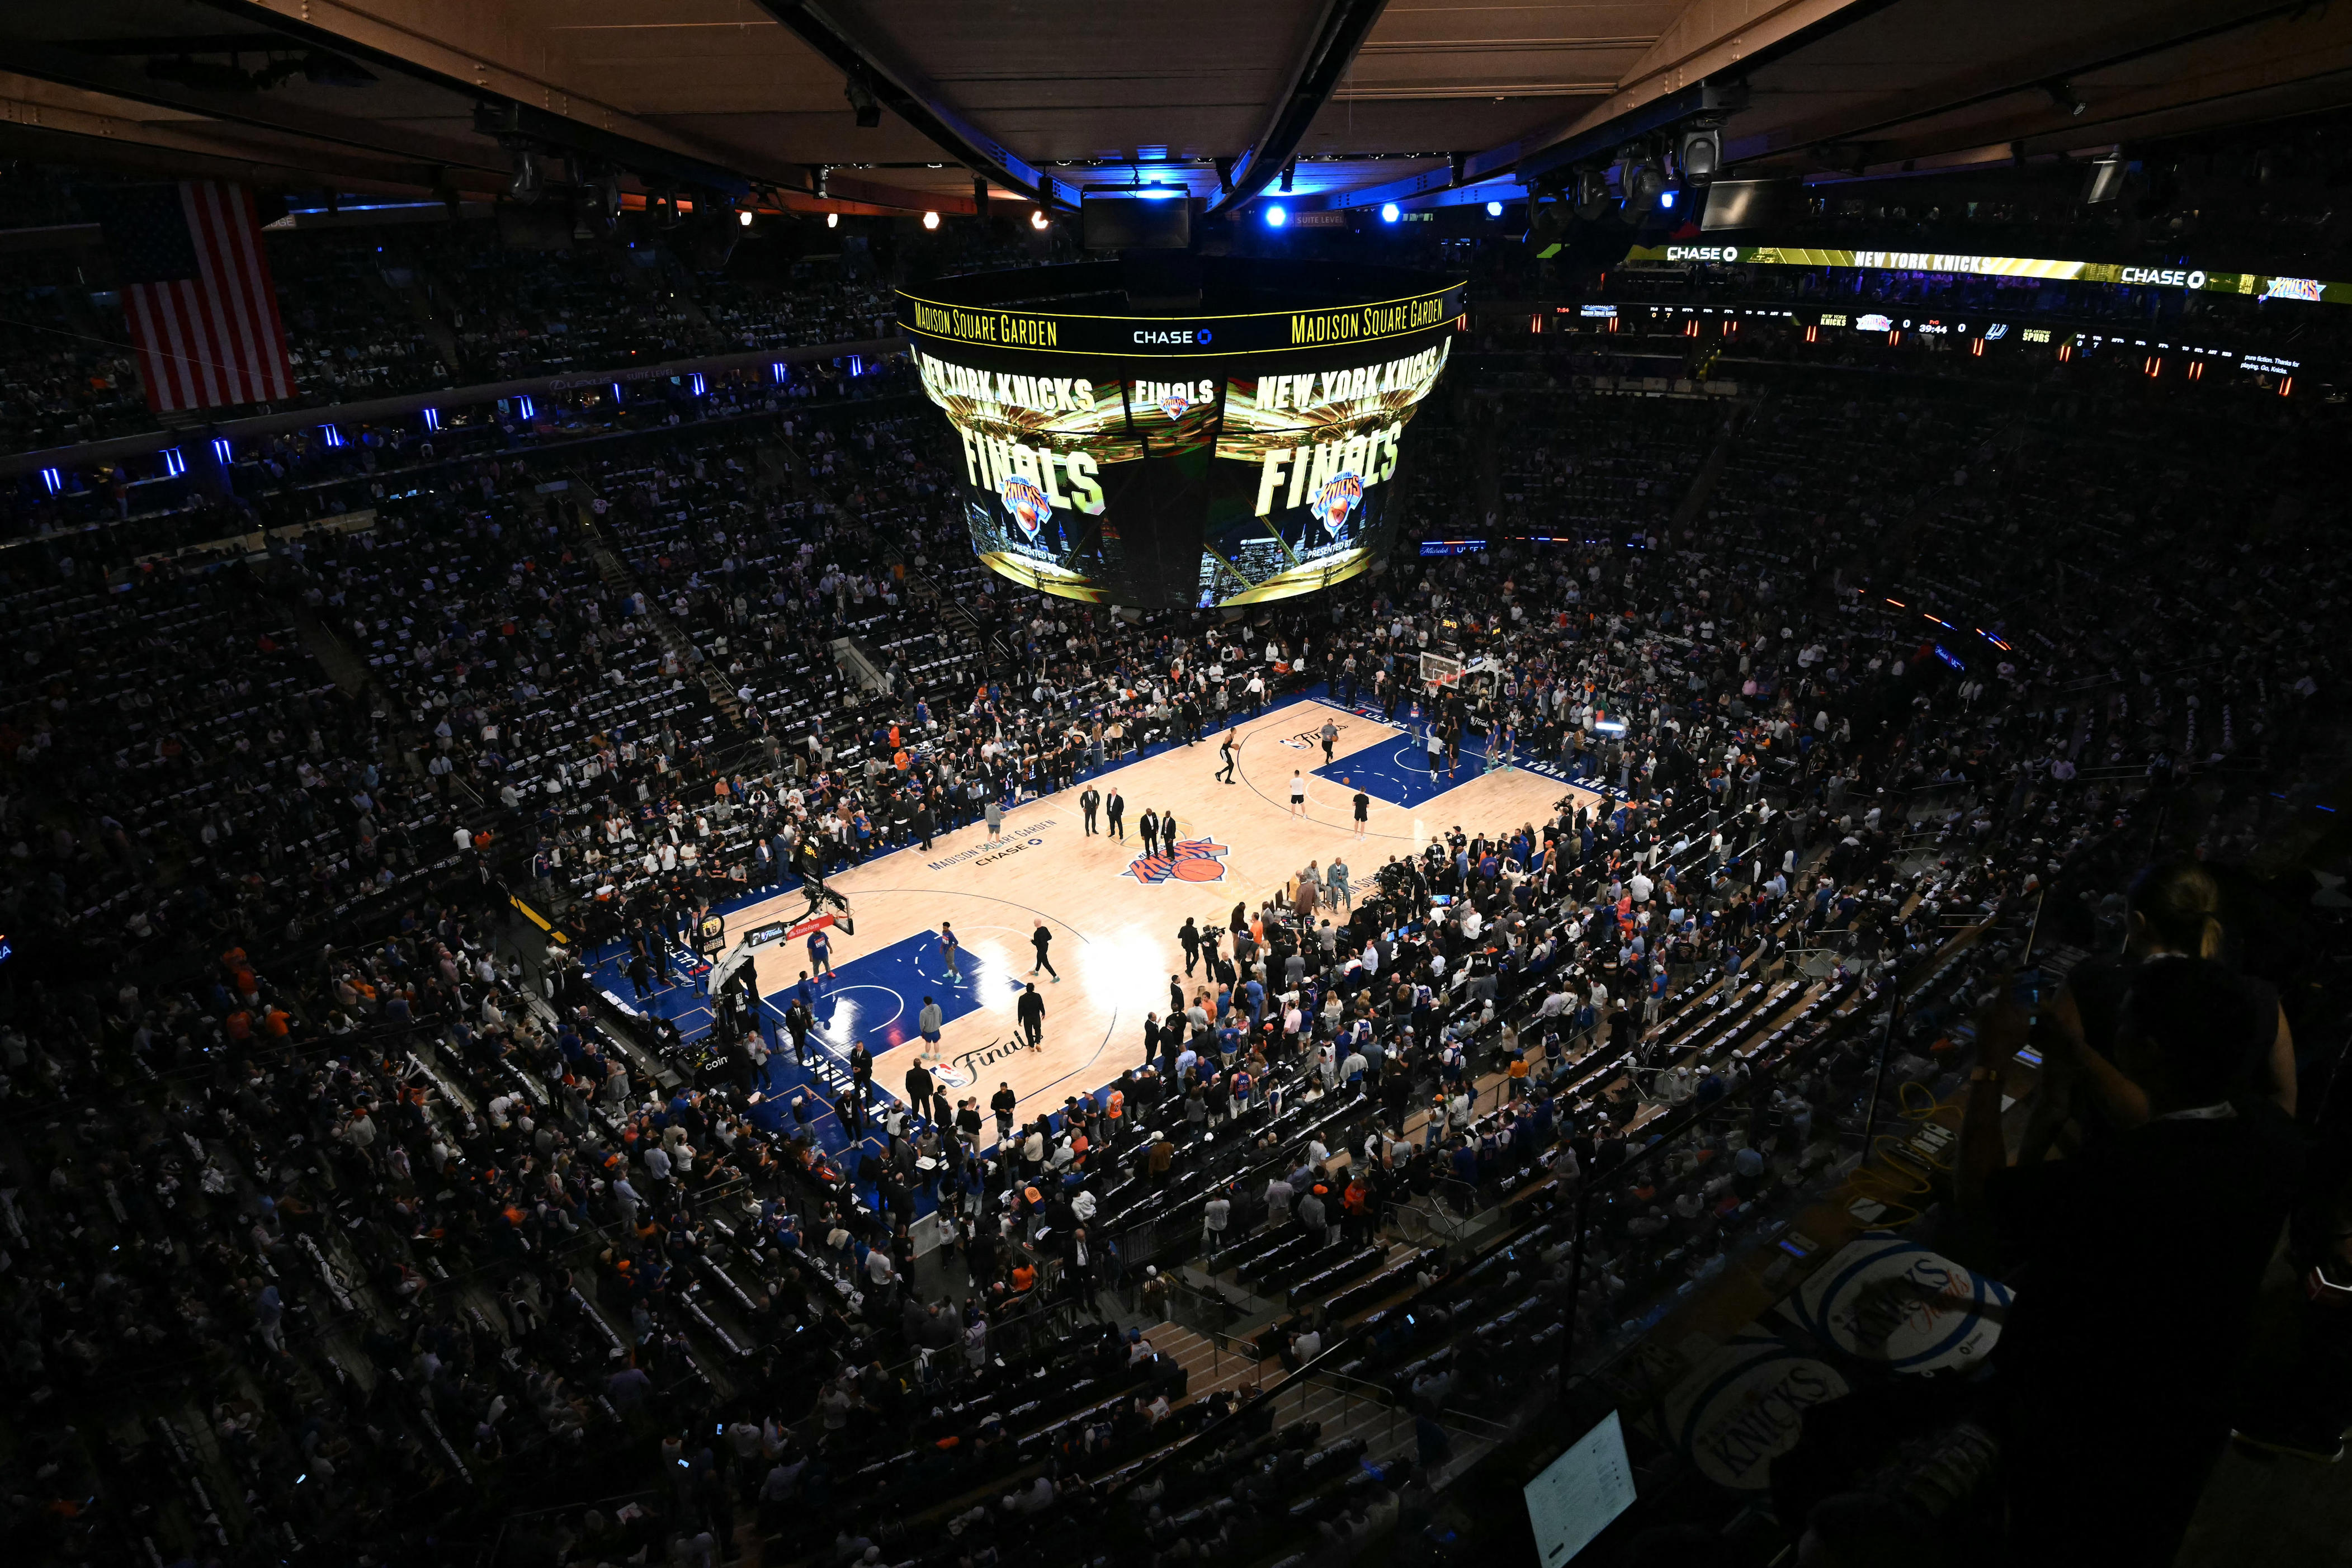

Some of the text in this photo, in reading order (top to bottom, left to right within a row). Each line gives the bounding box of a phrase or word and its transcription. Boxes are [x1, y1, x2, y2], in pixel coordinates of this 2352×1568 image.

[1666, 247, 1720, 261] CHASE
[1854, 251, 1991, 272] NEW YORK KNICKS
[2121, 267, 2186, 286] CHASE
[2269, 277, 2318, 299] KNICKS
[1820, 318, 1846, 327] KNICKS
[1902, 319, 1910, 328] 0
[1919, 324, 1947, 334] 39:44
[1958, 323, 1966, 333] 0
[1134, 331, 1193, 344] CHASE
[2022, 332, 2050, 343] SPURS
[2240, 362, 2259, 371] playing.
[2274, 358, 2292, 366] Thanks
[945, 361, 996, 404] YORK
[996, 372, 1097, 412] KNICKS
[1255, 372, 1316, 410] NEW
[1321, 363, 1382, 405] YORK
[1383, 346, 1437, 394] KNICKS
[1135, 379, 1214, 405] FINALS
[1161, 398, 1188, 408] KNICKS
[960, 424, 1106, 516] FINALS
[1254, 420, 1402, 517] FINALS
[1003, 480, 1050, 513] KNICKS
[1314, 475, 1361, 509] KNICKS
[1012, 542, 1057, 562] PRESENTED BY
[1307, 537, 1354, 559] PRESENTED BY
[1419, 546, 1449, 555] Michelob
[1442, 619, 1457, 629] 39:43
[1475, 716, 1490, 728] Finals
[1524, 761, 1567, 779] YORK
[1573, 777, 1632, 801] KNICK
[804, 844, 818, 859] 39:4
[975, 843, 1029, 866] CHASE
[1130, 840, 1228, 872] KNCKS
[807, 875, 819, 885] TISSOT
[764, 927, 783, 941] Finals
[705, 1055, 728, 1071] coin
[952, 1029, 1043, 1087] Final
[1713, 1367, 1826, 1476] KNICKS
